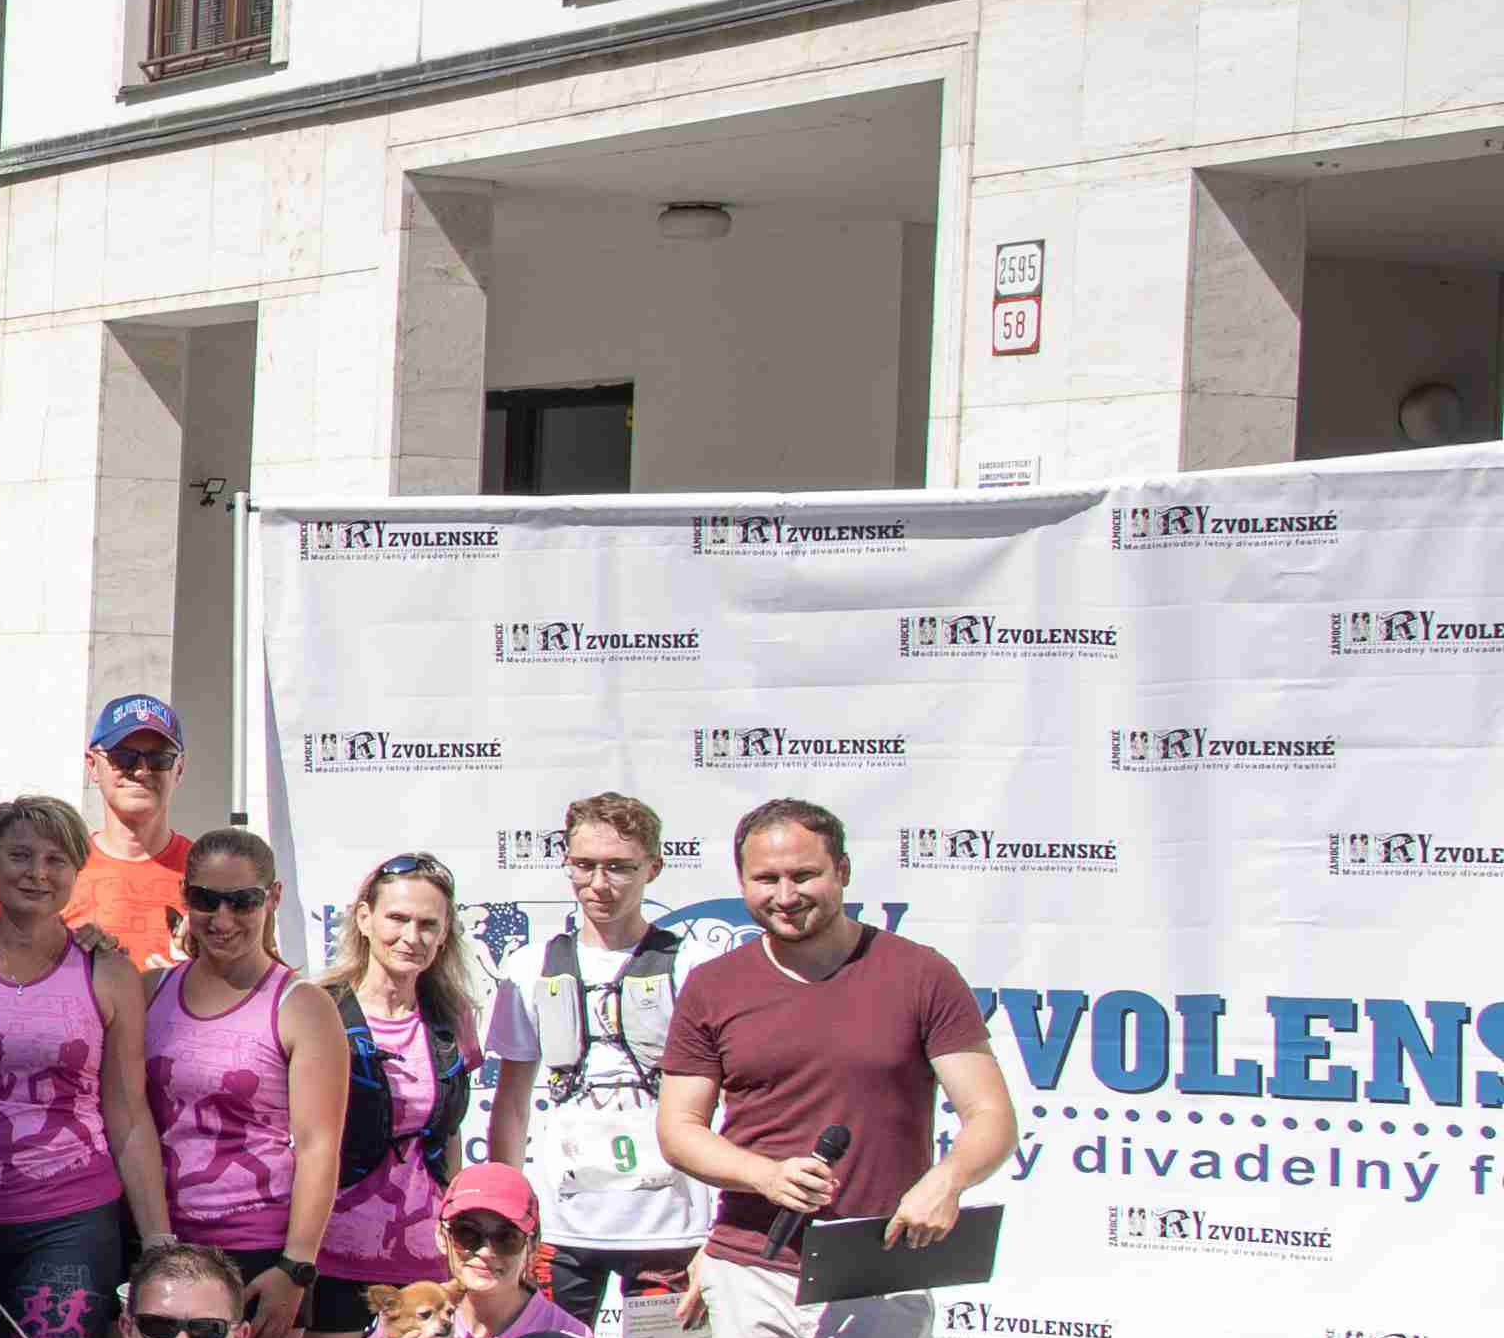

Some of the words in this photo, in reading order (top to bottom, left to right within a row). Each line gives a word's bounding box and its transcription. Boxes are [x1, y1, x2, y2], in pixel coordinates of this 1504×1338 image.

[1000, 254, 1037, 286] 2595
[1003, 310, 1026, 340] 58
[787, 519, 904, 542] ZVOLENSKÉ
[1212, 510, 1337, 533] ZVOLENSKÉ
[389, 526, 498, 547] ZVOLENSKÉ
[586, 628, 699, 649] ZVOLENSKÉ
[997, 625, 1117, 646] ZVOLENSKÉ
[392, 737, 501, 758] ZVOLENSKÉ
[789, 734, 905, 755] ZVOLENSKÉ
[1209, 735, 1335, 757] ZVOLENSKÉ
[997, 839, 1117, 860] ZVOLENSKÉ
[611, 1135, 638, 1174] 9
[1072, 1133, 1439, 1202] divadelný
[1208, 1227, 1332, 1249] ZVOLENSKÉ
